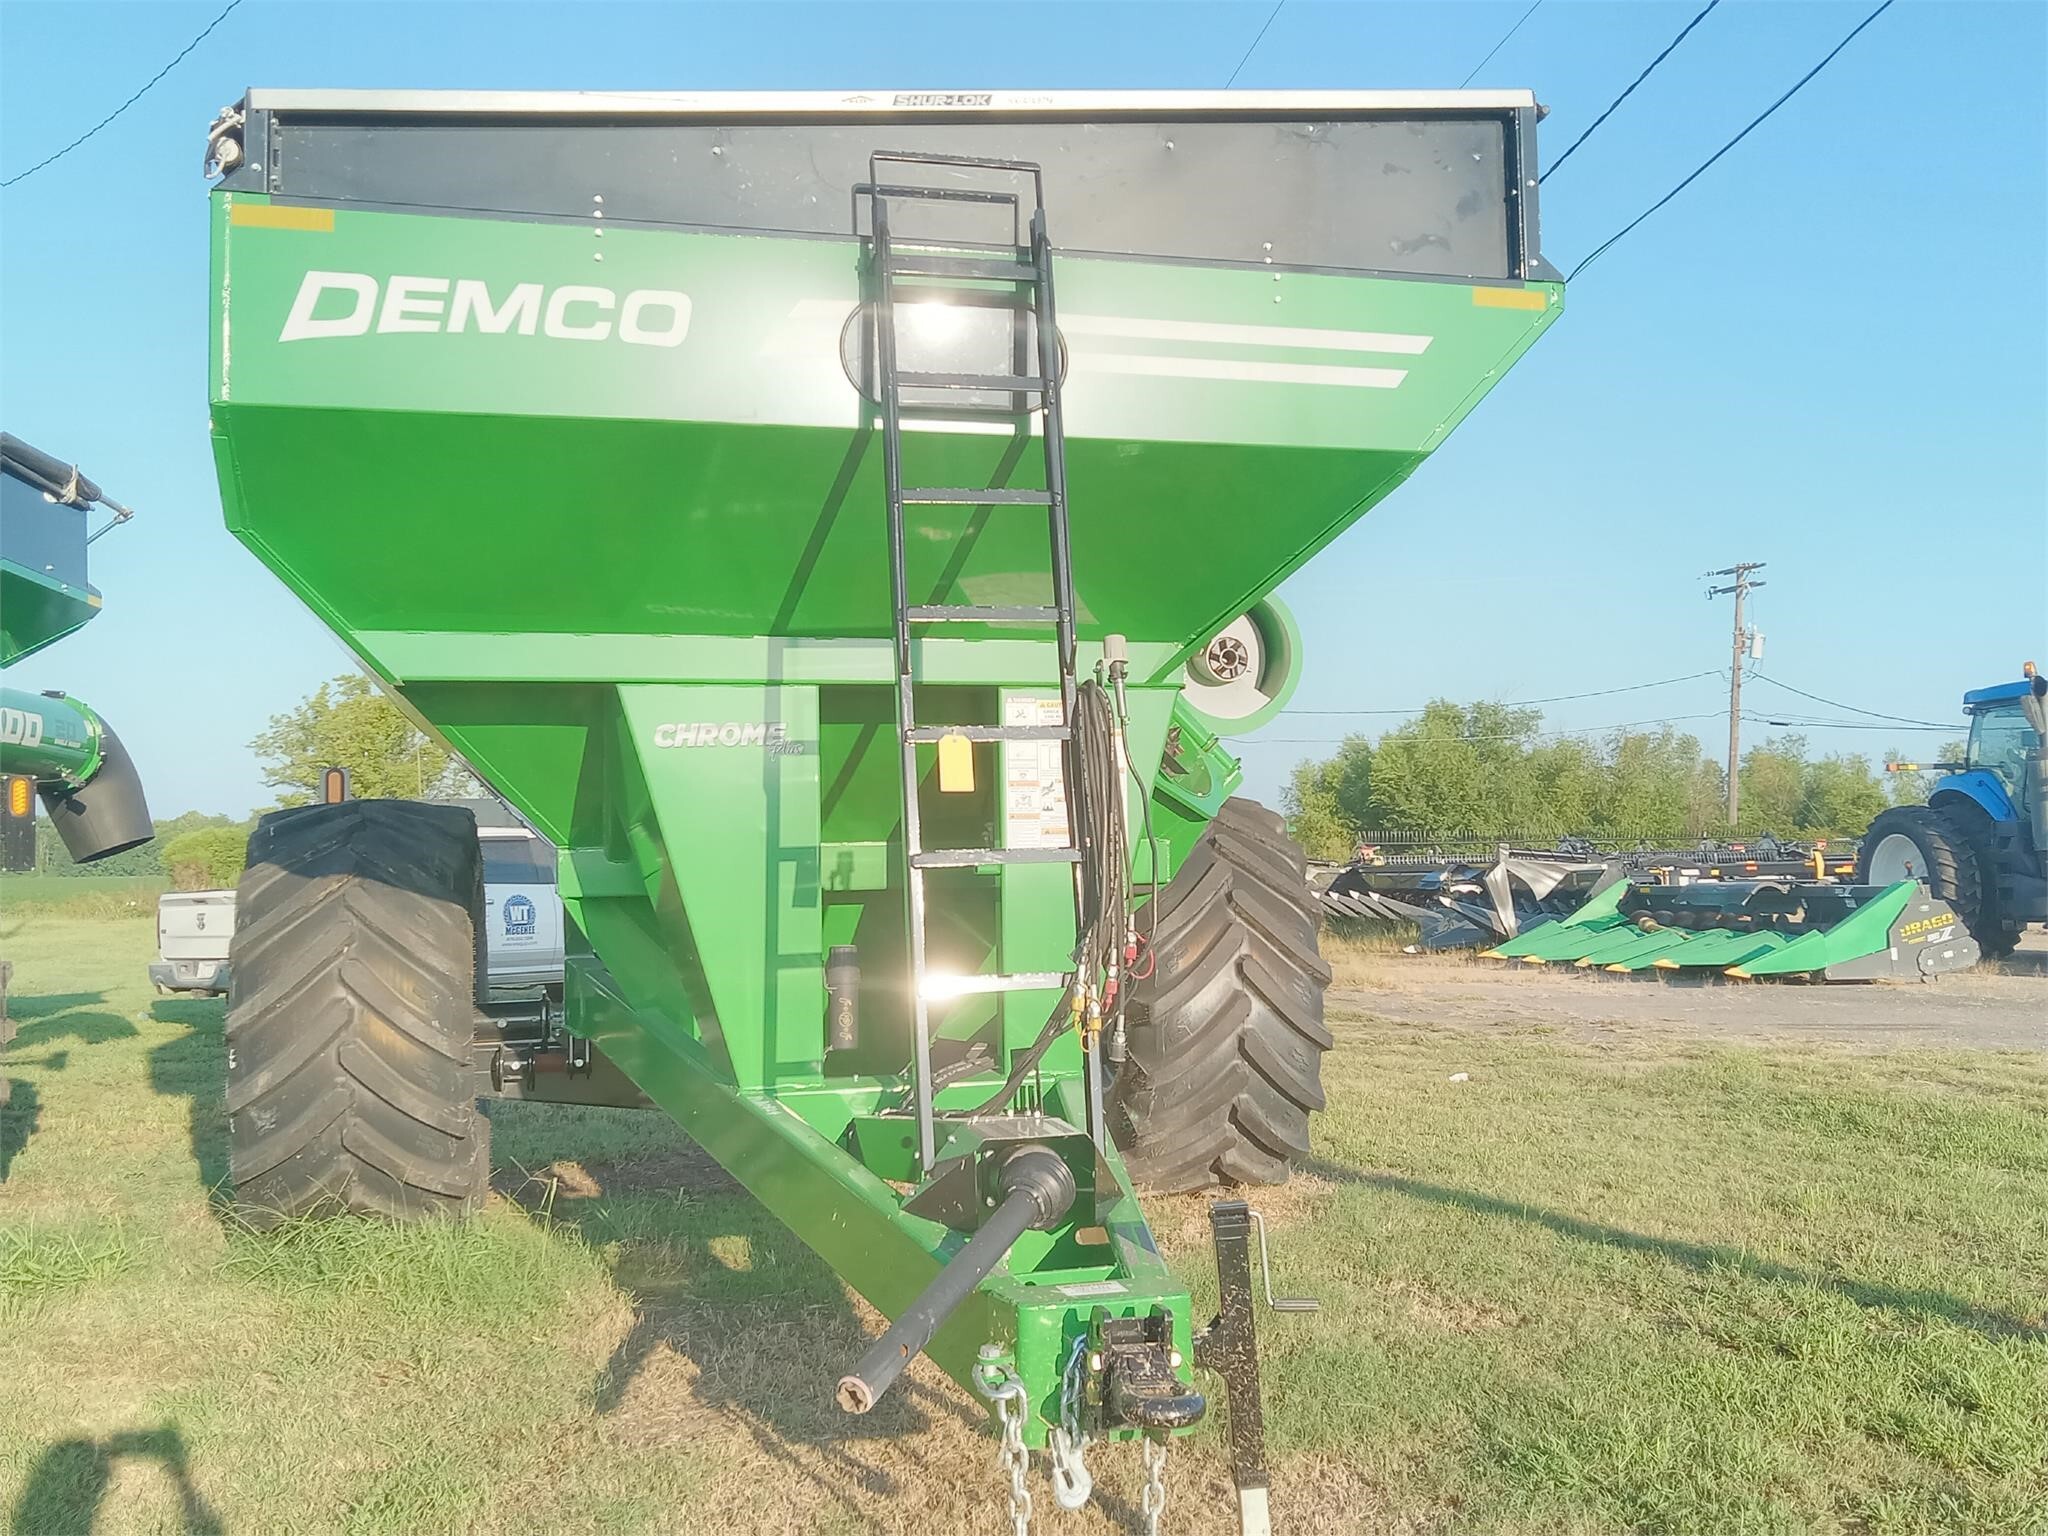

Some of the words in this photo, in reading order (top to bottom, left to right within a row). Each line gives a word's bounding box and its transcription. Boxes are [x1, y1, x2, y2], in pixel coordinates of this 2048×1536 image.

[893, 94, 991, 106] SHUR-LOK
[278, 270, 693, 347] DEMCO
[654, 721, 788, 748] CHROME
